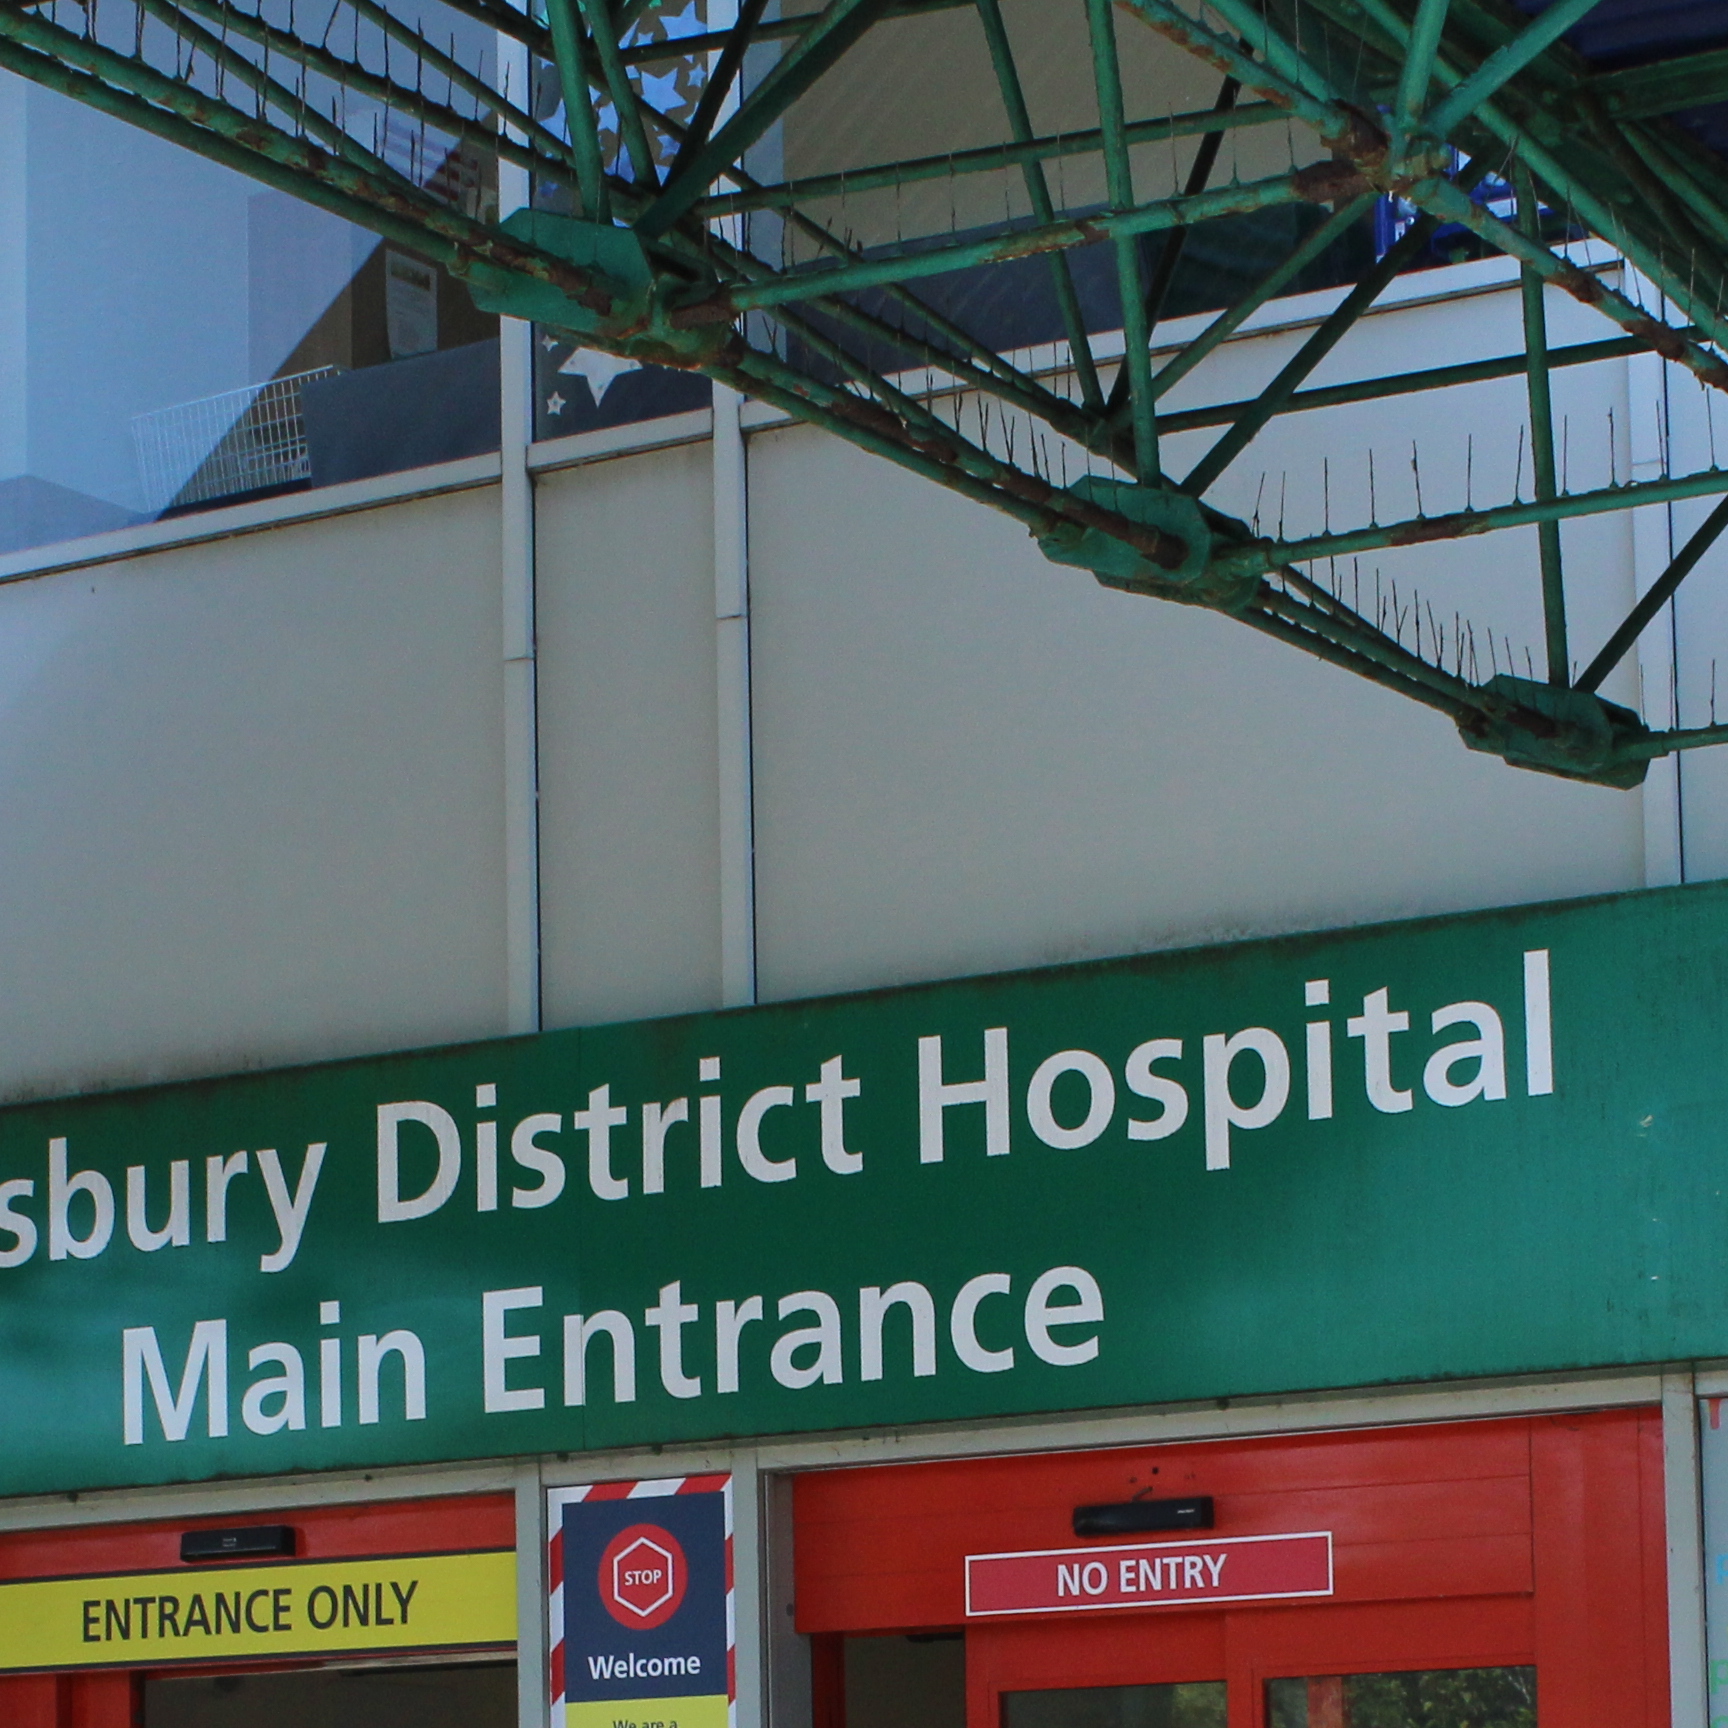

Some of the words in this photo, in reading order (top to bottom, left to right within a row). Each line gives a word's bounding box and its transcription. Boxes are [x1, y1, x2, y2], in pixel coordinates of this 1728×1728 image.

[376, 1053, 864, 1225] District
[917, 949, 1554, 1171] Hospital
[122, 1299, 427, 1446] Main
[482, 1264, 1106, 1416] Entrance
[624, 1569, 662, 1587] STOP
[1057, 1561, 1108, 1597] NO
[1119, 1553, 1227, 1593] ENTRY
[82, 1588, 293, 1643] ENTRANCE
[306, 1580, 419, 1630] ONLY
[588, 1653, 702, 1681] Welcome
